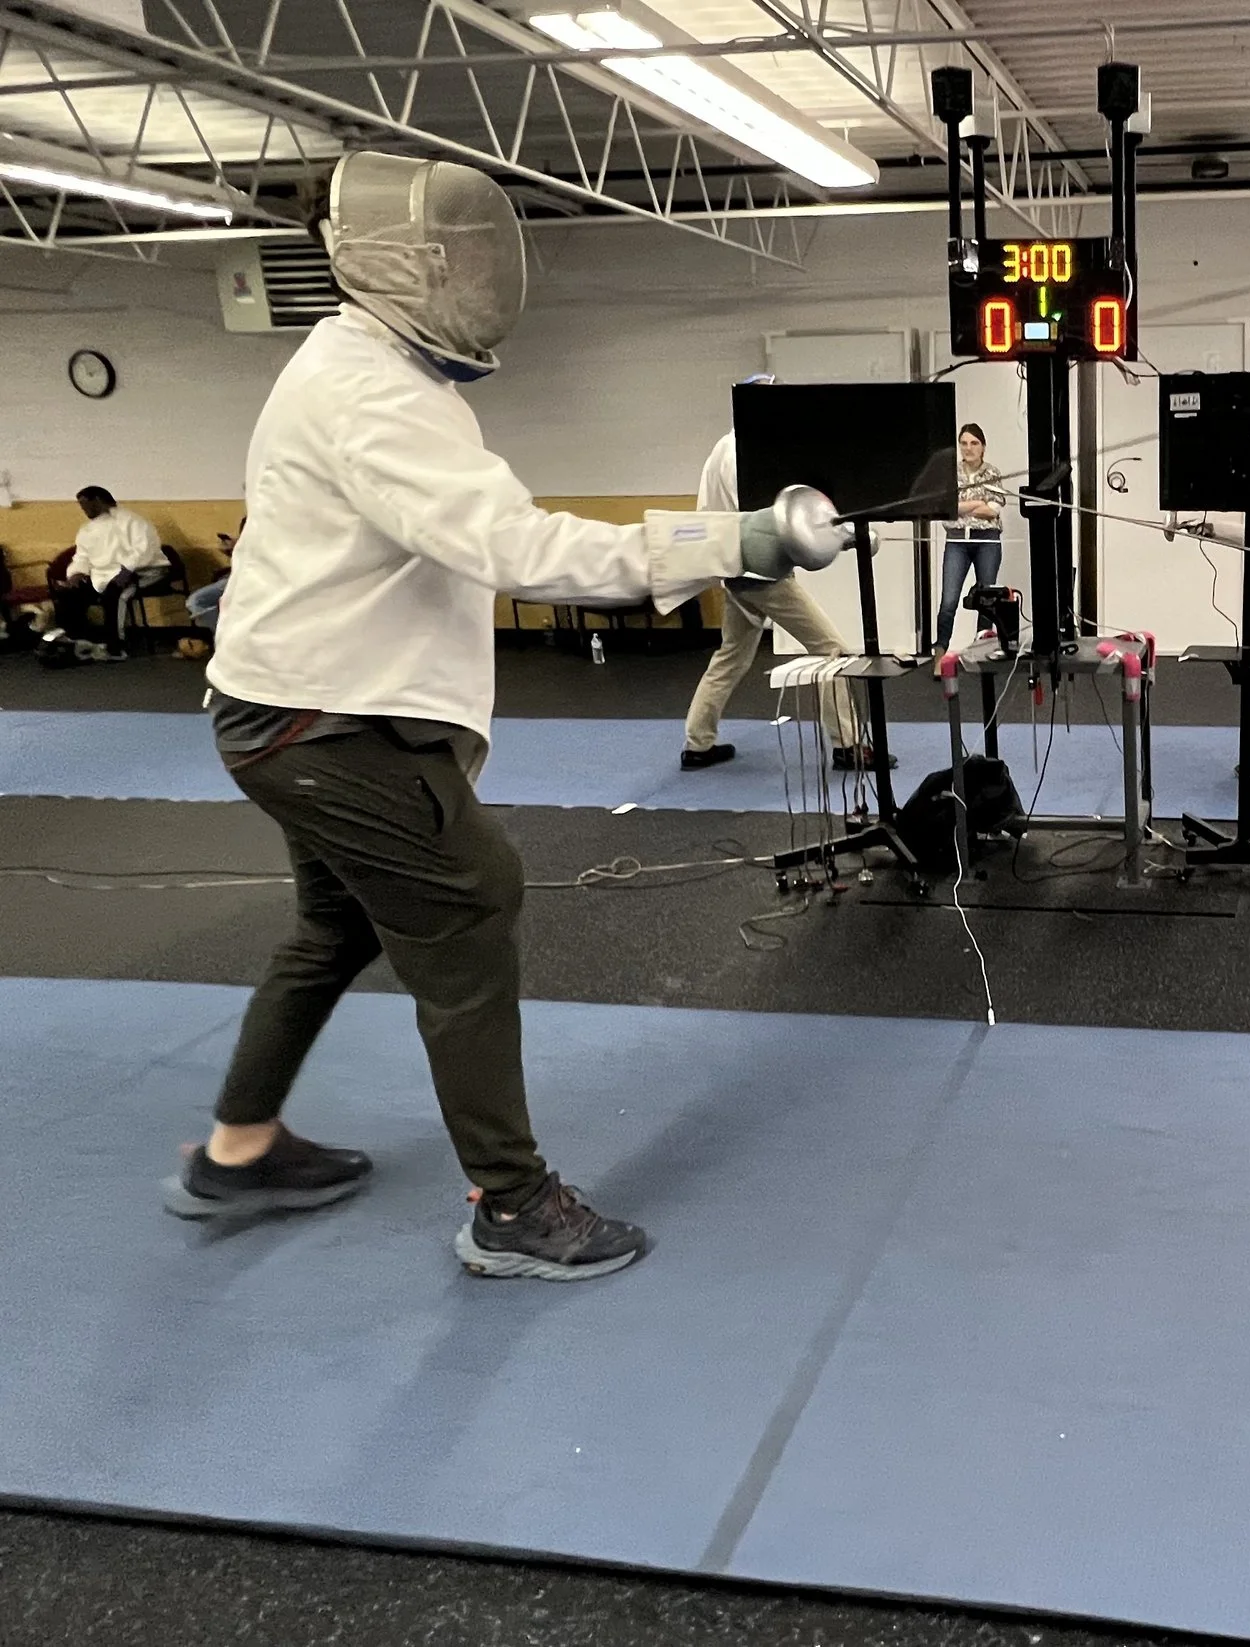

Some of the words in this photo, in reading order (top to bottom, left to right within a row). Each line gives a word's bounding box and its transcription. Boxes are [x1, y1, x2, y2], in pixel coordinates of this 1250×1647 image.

[1003, 244, 1072, 283] 3:00
[1039, 286, 1047, 318] 1
[984, 301, 1012, 353] 0
[1094, 301, 1121, 352] 0
